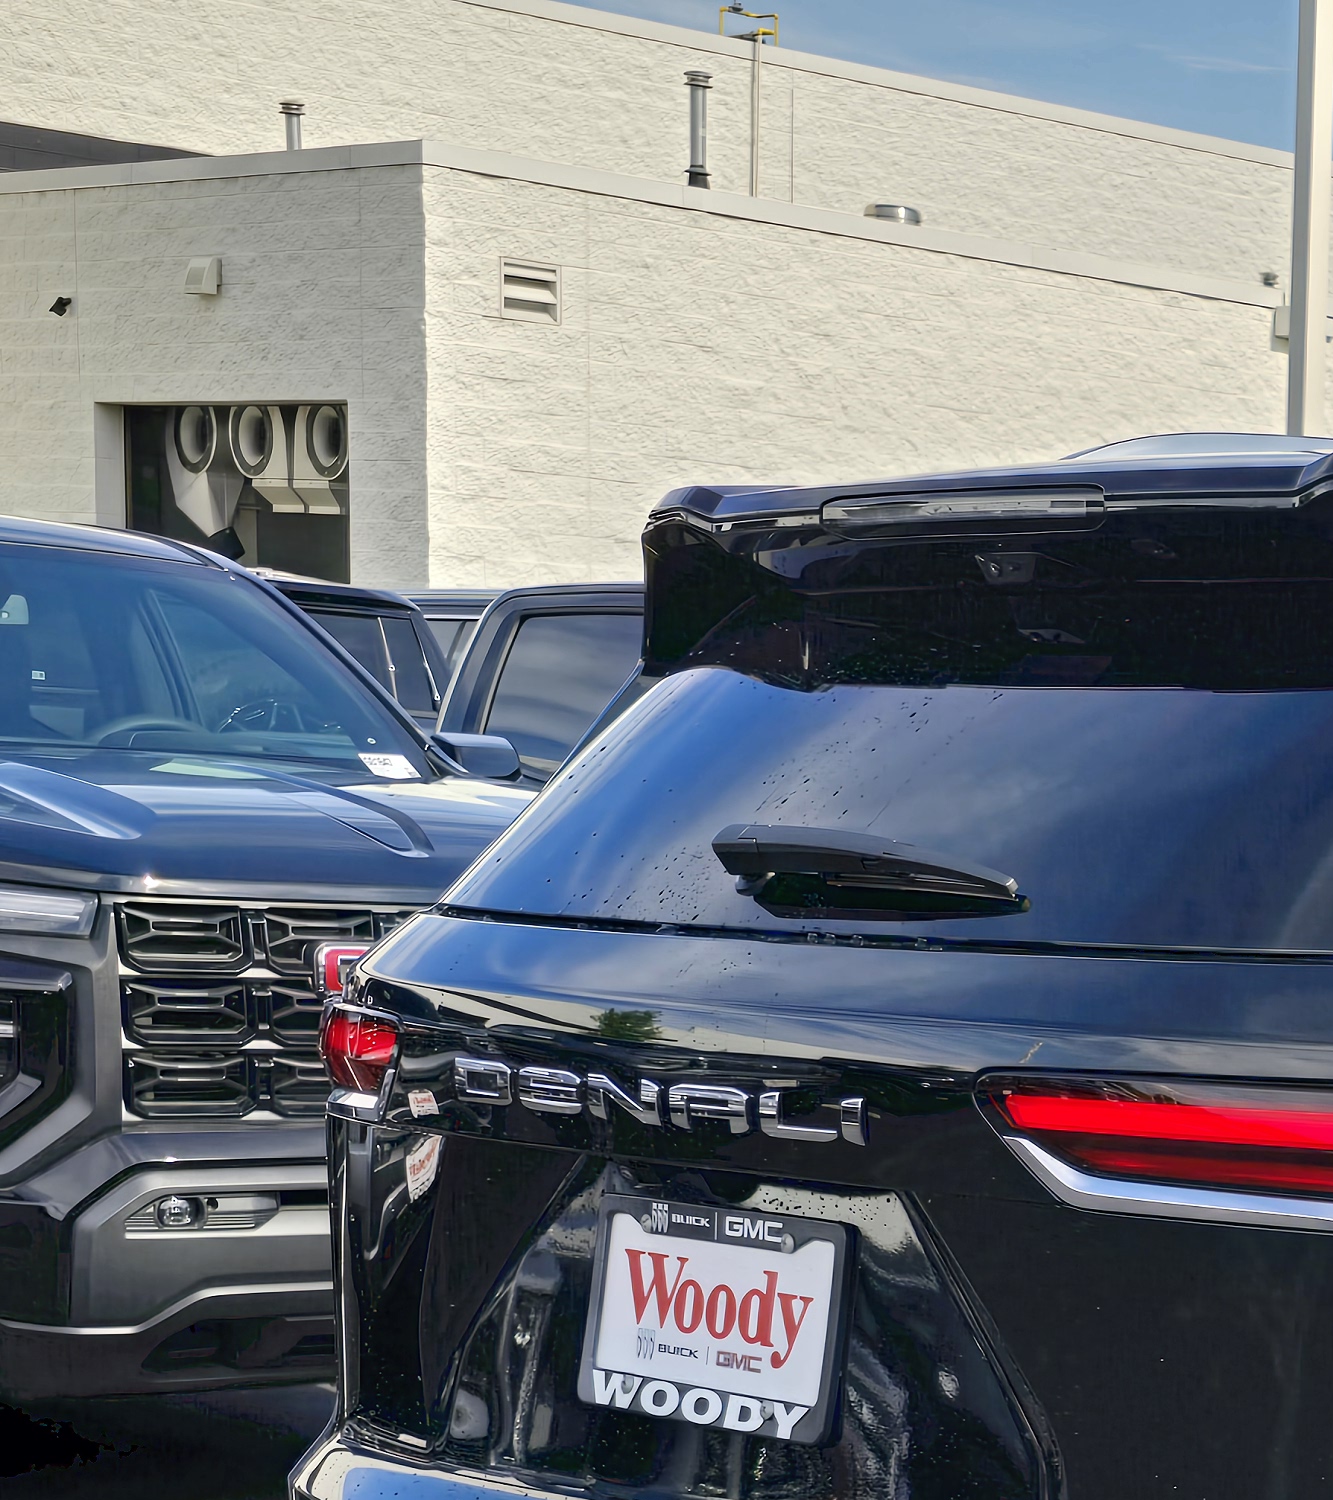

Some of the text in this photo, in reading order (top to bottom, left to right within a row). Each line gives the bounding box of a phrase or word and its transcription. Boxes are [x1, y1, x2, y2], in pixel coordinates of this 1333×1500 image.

[453, 1056, 867, 1147] DENALI
[671, 1212, 783, 1243] BUICK GMC
[624, 1248, 815, 1370] Woody
[657, 1342, 763, 1374] BUICK GMC
[592, 1368, 810, 1440] WOODY
